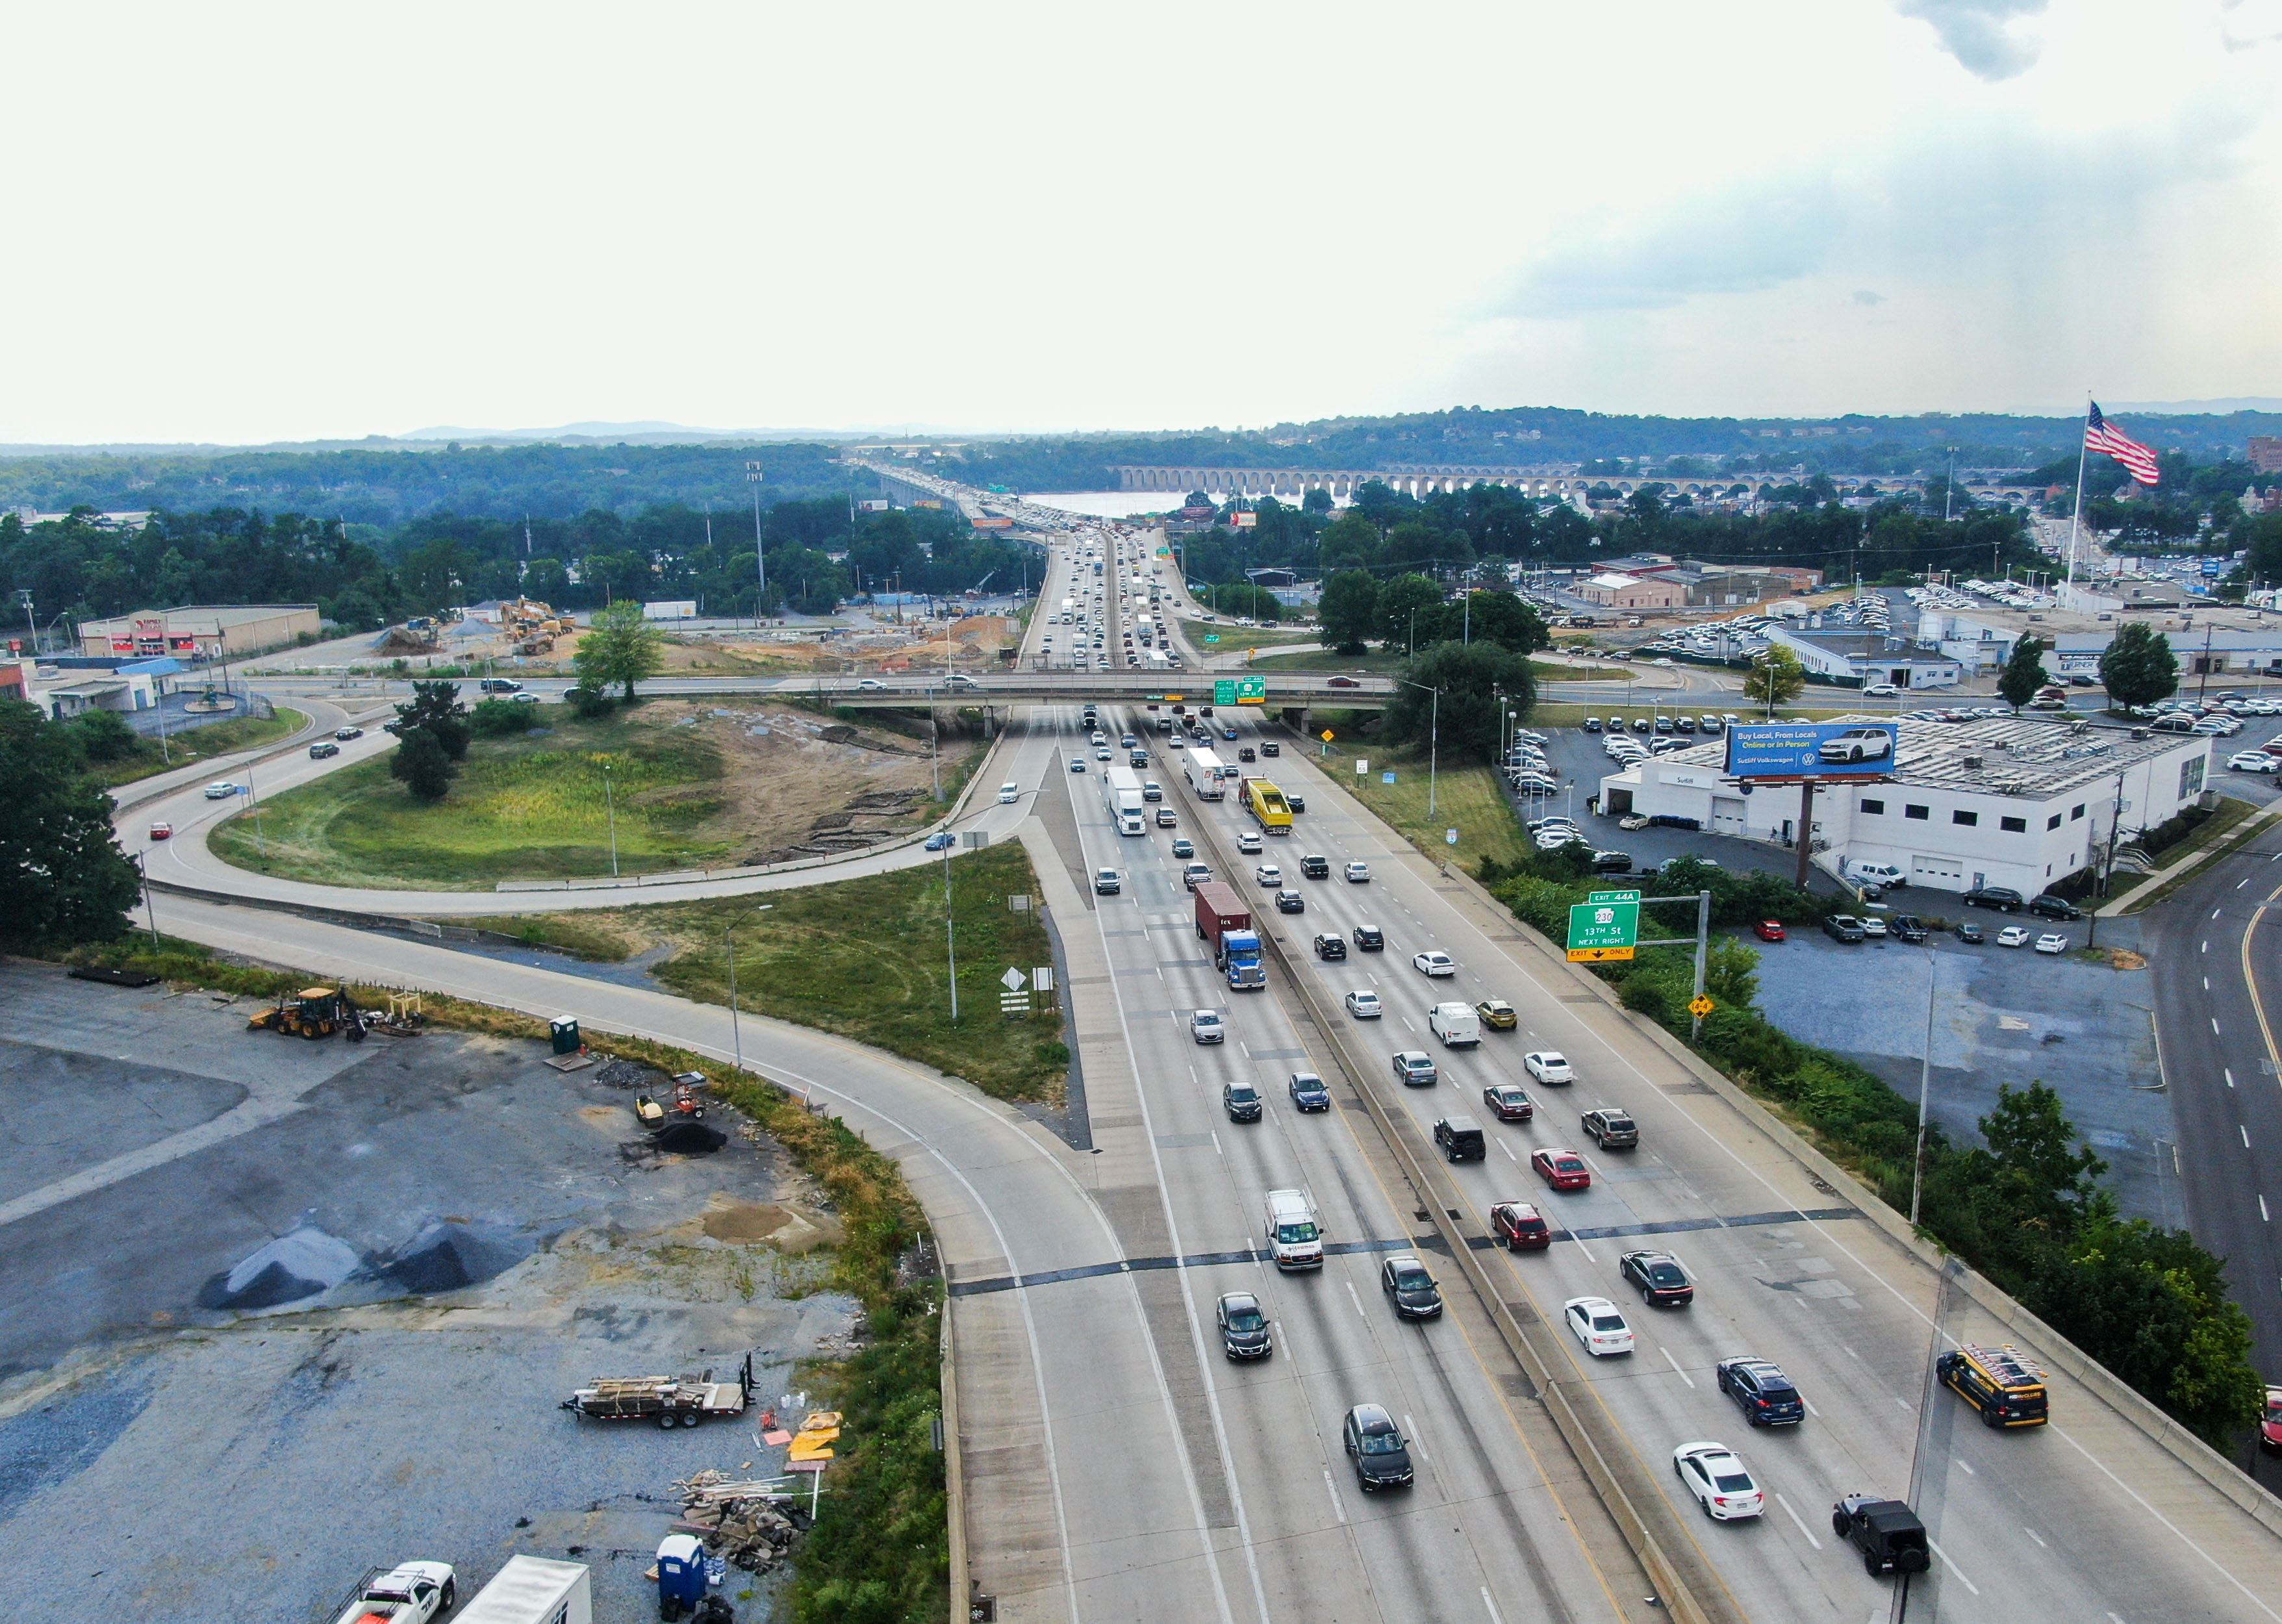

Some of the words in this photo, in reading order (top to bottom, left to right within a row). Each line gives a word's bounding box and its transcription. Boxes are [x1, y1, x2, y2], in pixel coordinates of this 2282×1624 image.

[1596, 913, 1612, 922] 230
[1584, 927, 1606, 935] 13TH
[1610, 926, 1621, 935] St
